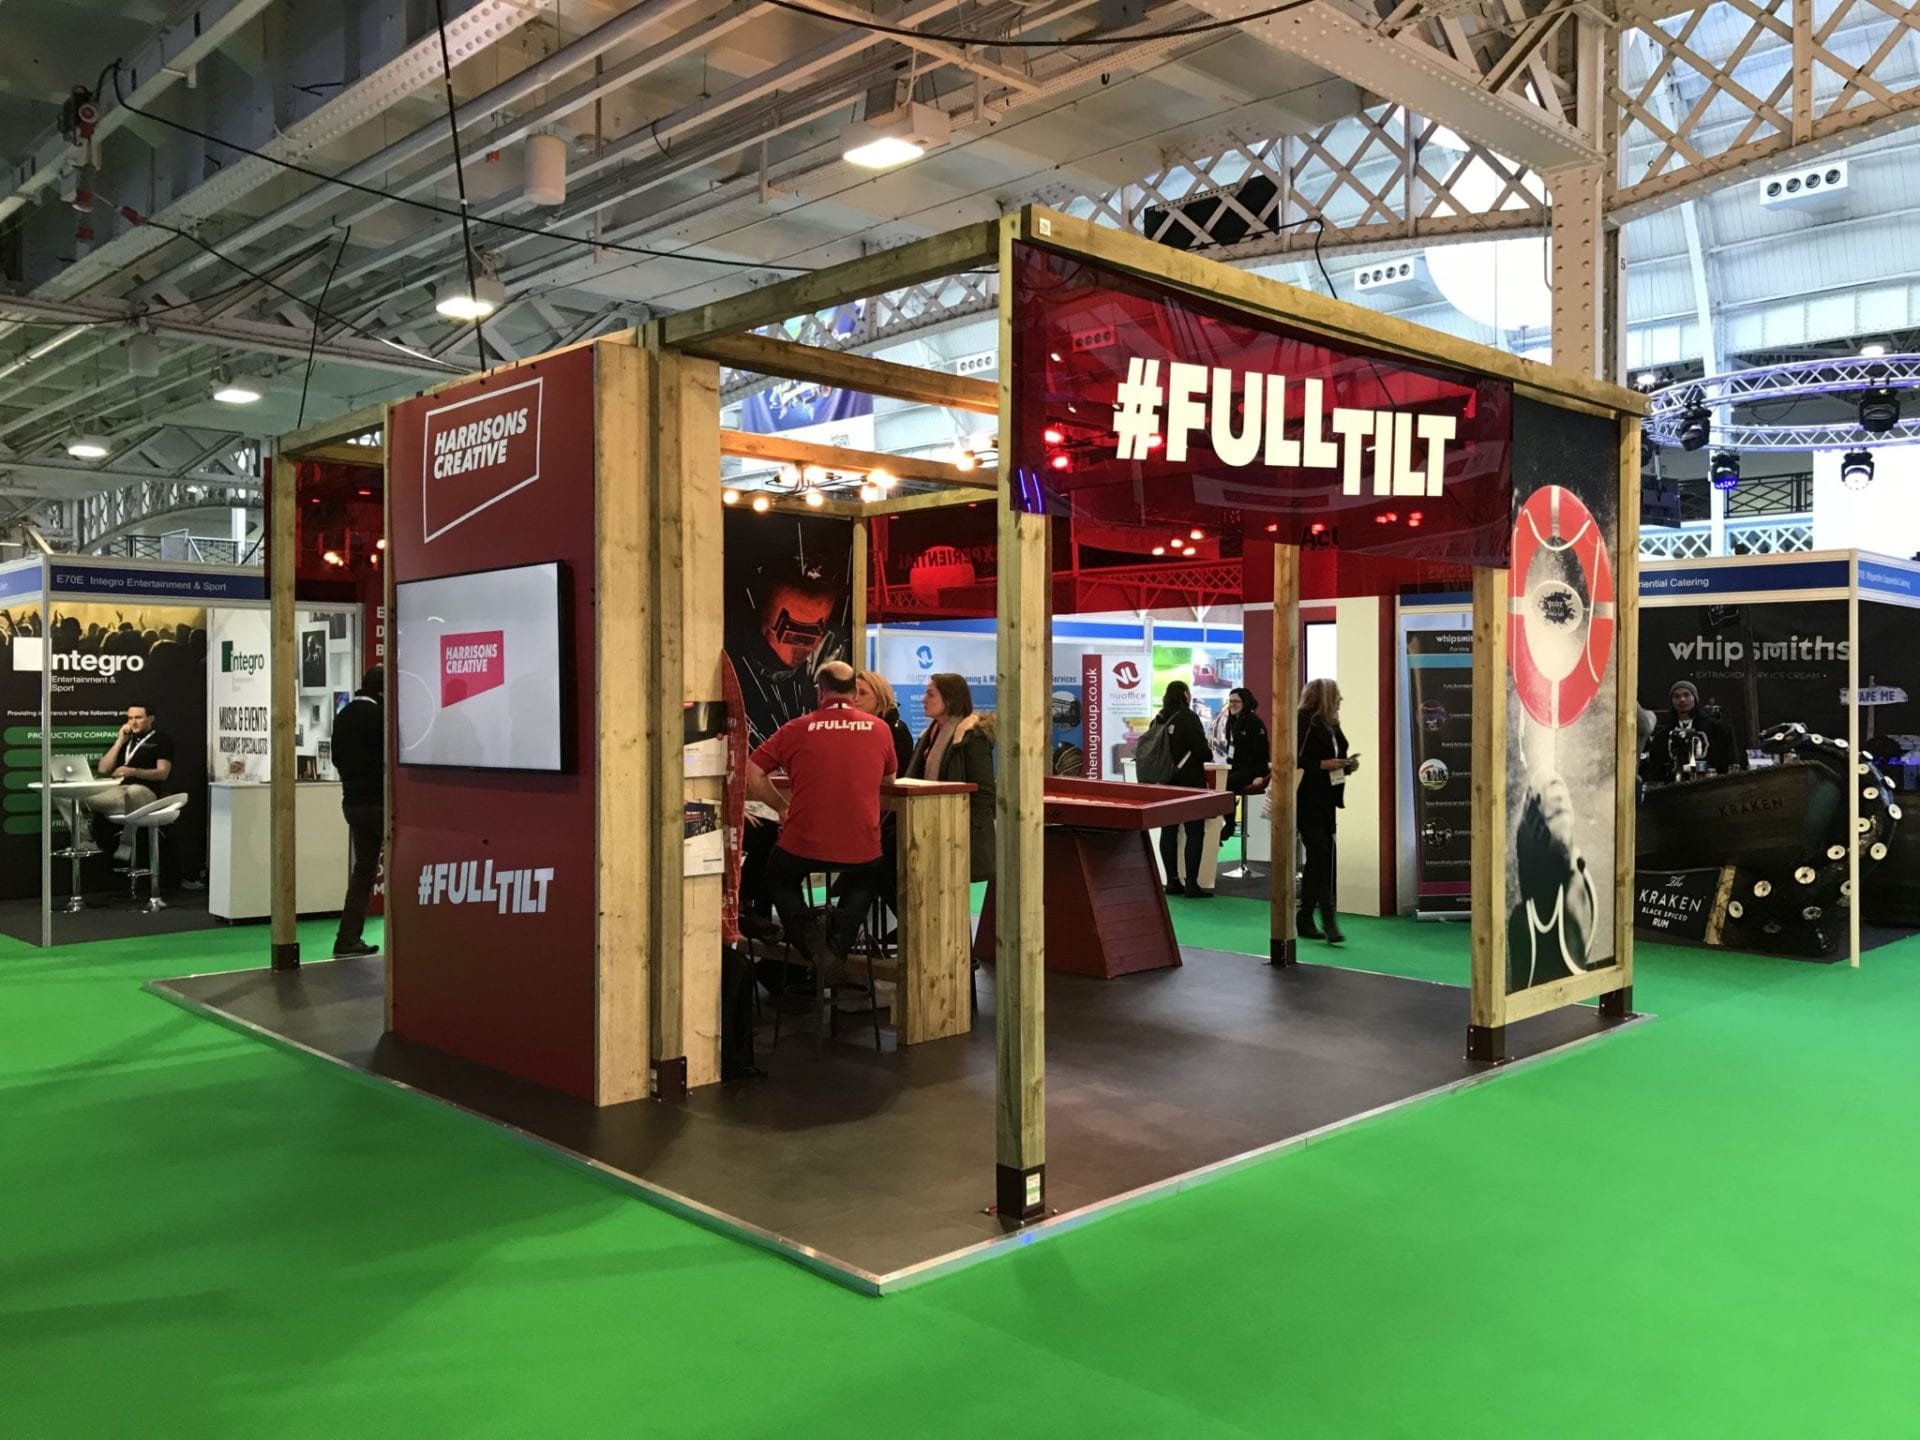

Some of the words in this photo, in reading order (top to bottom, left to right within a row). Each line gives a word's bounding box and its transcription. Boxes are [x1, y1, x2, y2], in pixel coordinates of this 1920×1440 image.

[434, 408, 529, 456] HARRISONS
[1113, 357, 1457, 497] #FULLTILT
[433, 439, 508, 480] CREATIVE
[56, 575, 84, 585] E70E
[90, 576, 124, 588] Integro
[127, 578, 191, 590] Entertainment
[193, 582, 200, 590] &
[203, 582, 227, 592] Sport
[1639, 578, 1668, 588] riential
[1670, 577, 1709, 588] Catering
[1435, 634, 1473, 645] whipsmi
[445, 643, 498, 660] HARRISONS
[52, 649, 144, 676] ntegro
[446, 659, 489, 674] CREATIVE
[52, 676, 107, 684] Entertainment
[1696, 671, 1768, 679] EXTRAORDIRY
[52, 685, 75, 693] Sport
[1880, 690, 1895, 702] ME
[219, 706, 237, 731] MUSIC
[244, 706, 268, 731] EVENTS
[808, 719, 875, 732] #FULLTILT
[1086, 667, 1101, 780] thenugroup.co.uk
[27, 732, 82, 740] PROUCTION
[84, 731, 118, 739] COMPAN
[1718, 797, 1783, 817] KRAKEN
[418, 858, 555, 915] #FULLTILT
[1666, 874, 1687, 887] The
[1639, 888, 1702, 912] KRAKEN
[1641, 906, 1662, 916] BLACK
[1663, 911, 1689, 921] SPICED
[1651, 917, 1670, 929] RUM
